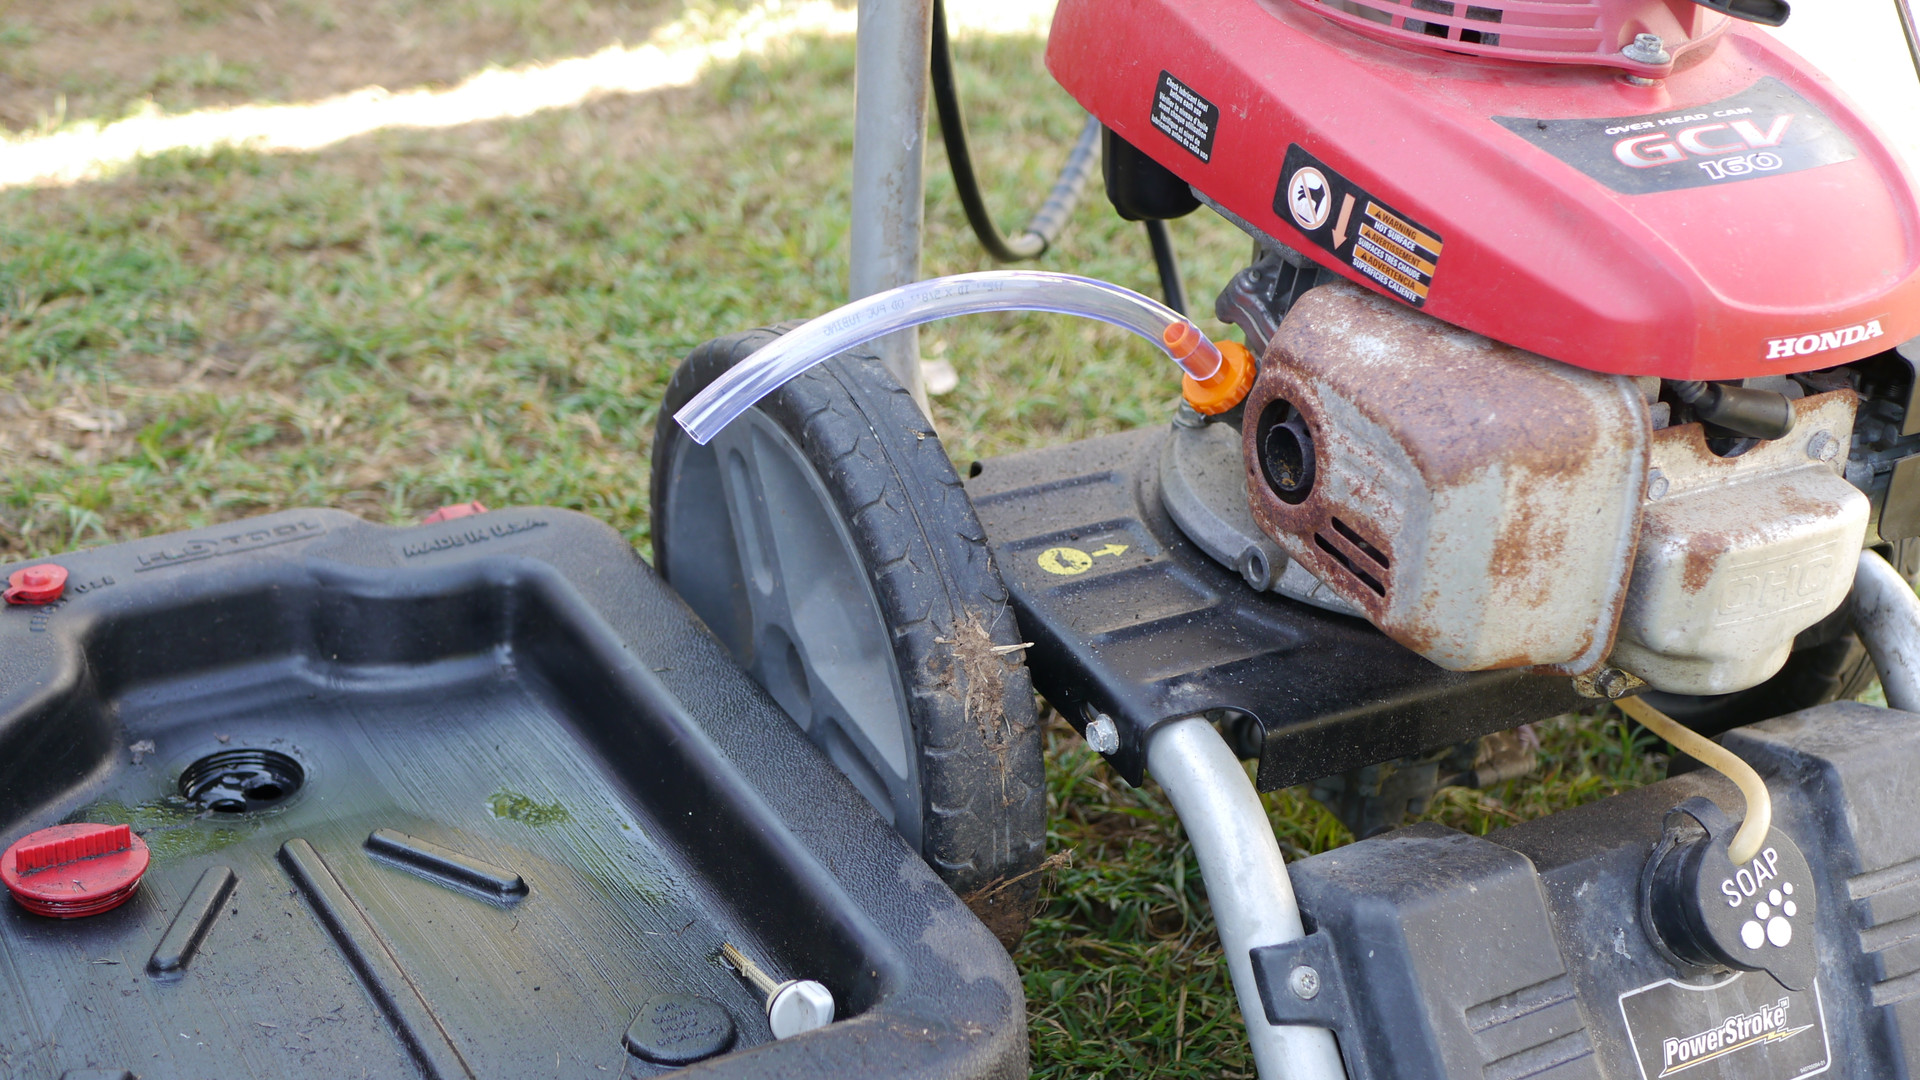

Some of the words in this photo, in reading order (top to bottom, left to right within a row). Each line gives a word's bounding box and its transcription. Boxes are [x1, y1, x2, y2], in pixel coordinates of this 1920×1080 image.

[1166, 76, 1179, 92] Check
[1179, 86, 1198, 105] lubricant
[1197, 99, 1209, 113] level
[1169, 88, 1183, 104] before
[1183, 99, 1194, 112] each
[1193, 106, 1202, 117] use
[1183, 129, 1195, 142] nivel
[1194, 137, 1201, 147] de
[1605, 121, 1655, 135] OVER
[1658, 113, 1708, 126] HEAD
[1713, 107, 1752, 118] CAM
[1183, 138, 1189, 147] de
[1189, 142, 1200, 155] cada
[1200, 150, 1209, 161] uso
[1612, 113, 1795, 169] GCV
[1698, 152, 1782, 180] 160
[1374, 221, 1388, 234] HOT
[1387, 228, 1416, 252] SURFACE
[1383, 210, 1417, 240] WARNING
[1358, 237, 1385, 259] SURFACES
[1397, 261, 1421, 281] CHAUDE
[1372, 233, 1421, 267] AVERTISSEMENT
[1352, 257, 1389, 286] SUPERFICIES
[1388, 279, 1417, 302] CALIENTE
[1368, 256, 1415, 290] ADVERTENCIA
[1766, 320, 1884, 359] HONDA
[1718, 553, 1834, 616] OHC
[1721, 847, 1778, 907] SOAP
[1665, 1004, 1785, 1066] PowerStroke
